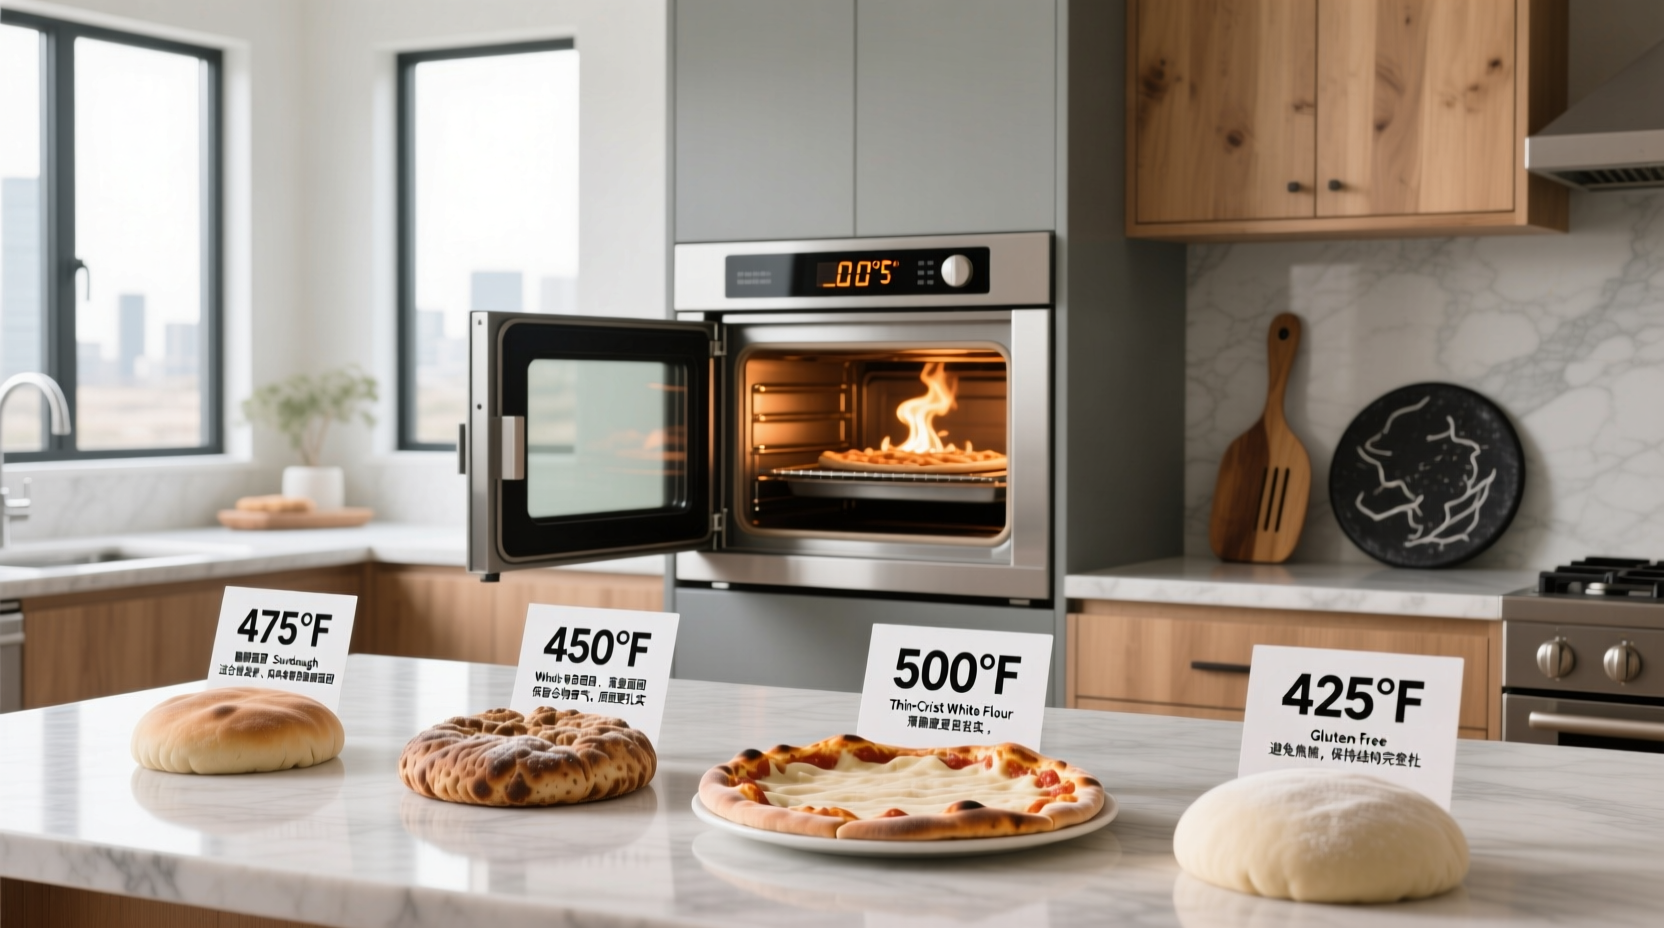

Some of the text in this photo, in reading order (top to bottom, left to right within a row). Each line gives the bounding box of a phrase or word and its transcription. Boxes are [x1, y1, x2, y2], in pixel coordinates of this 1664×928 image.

[237, 608, 333, 647] 475°F
[543, 626, 652, 667] 450°F
[893, 647, 1022, 695] 500°F
[947, 702, 980, 717] White
[982, 705, 1014, 720] Flour
[1282, 673, 1425, 723] 425°F
[1310, 729, 1388, 747] Gluten Free
